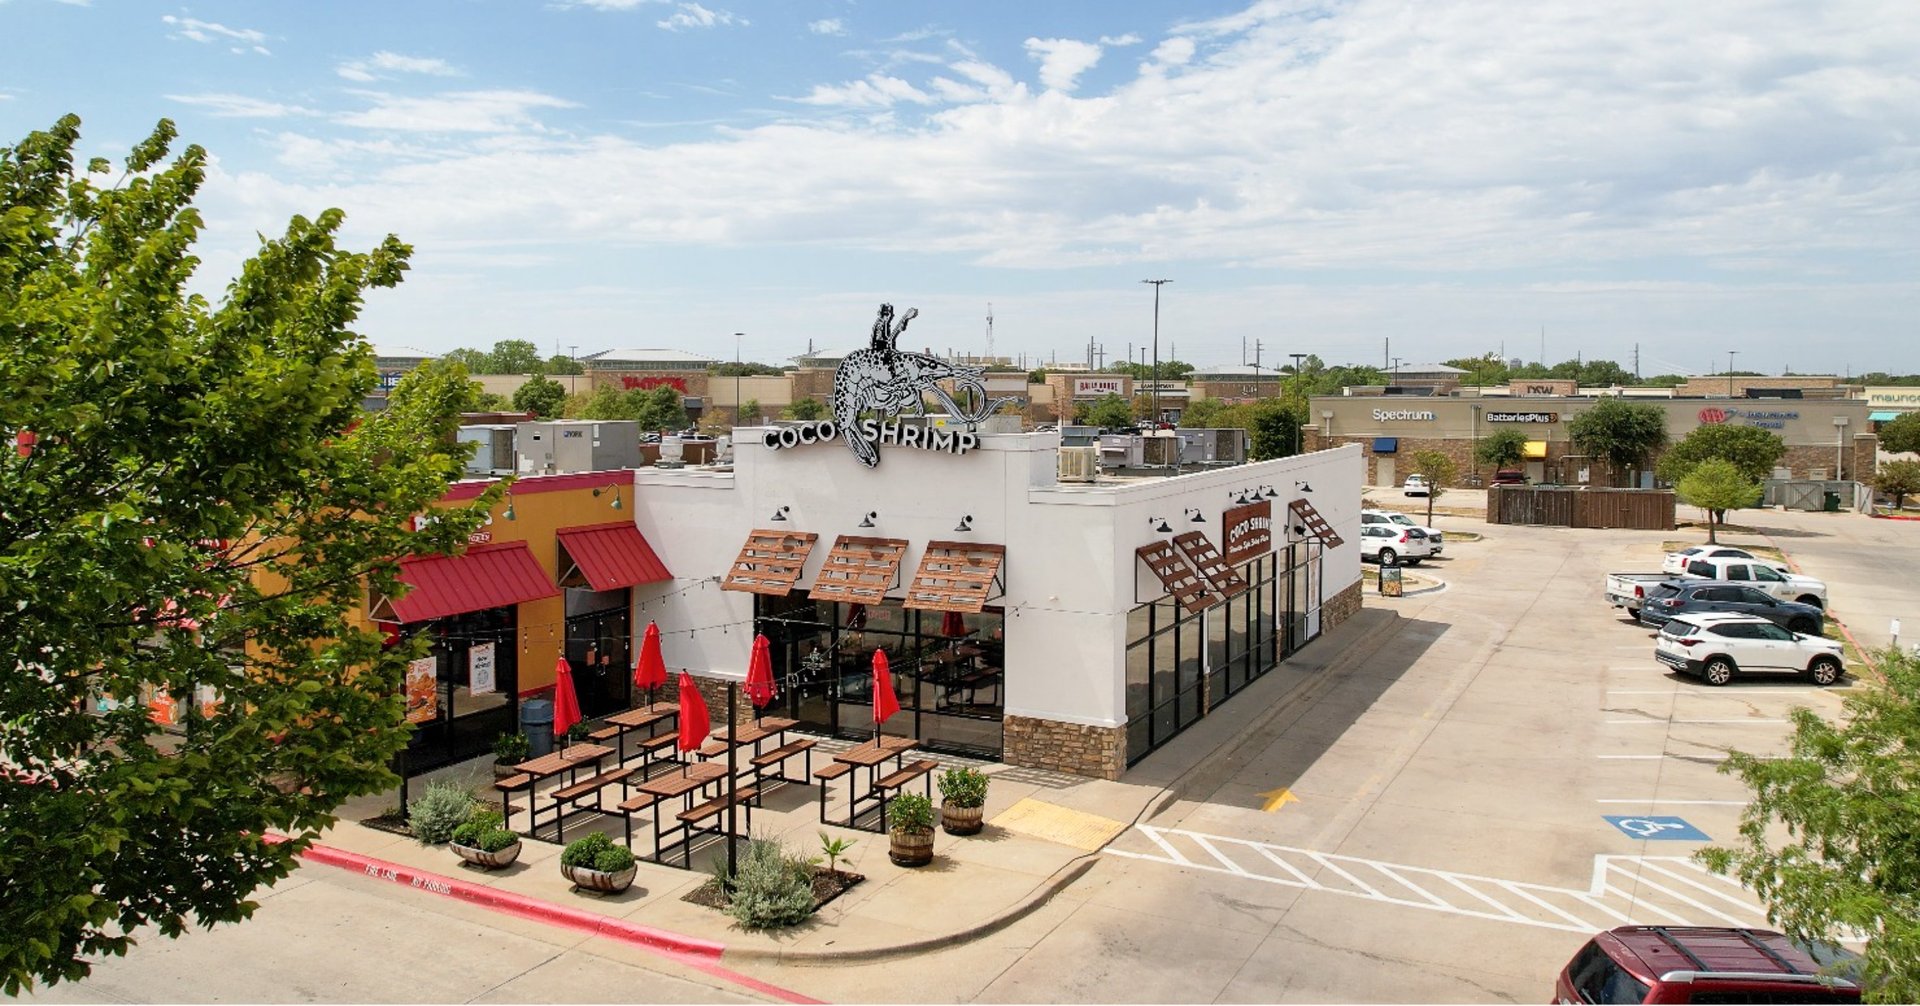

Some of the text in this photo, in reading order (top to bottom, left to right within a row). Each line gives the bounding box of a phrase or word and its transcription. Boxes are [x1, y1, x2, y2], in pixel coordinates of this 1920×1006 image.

[1372, 408, 1433, 422] Spectrum
[1486, 413, 1549, 423] BatteriesPlus
[1700, 408, 1725, 422] AAA
[762, 419, 979, 455] COCO SHRIMP
[1229, 520, 1250, 543] COCO
